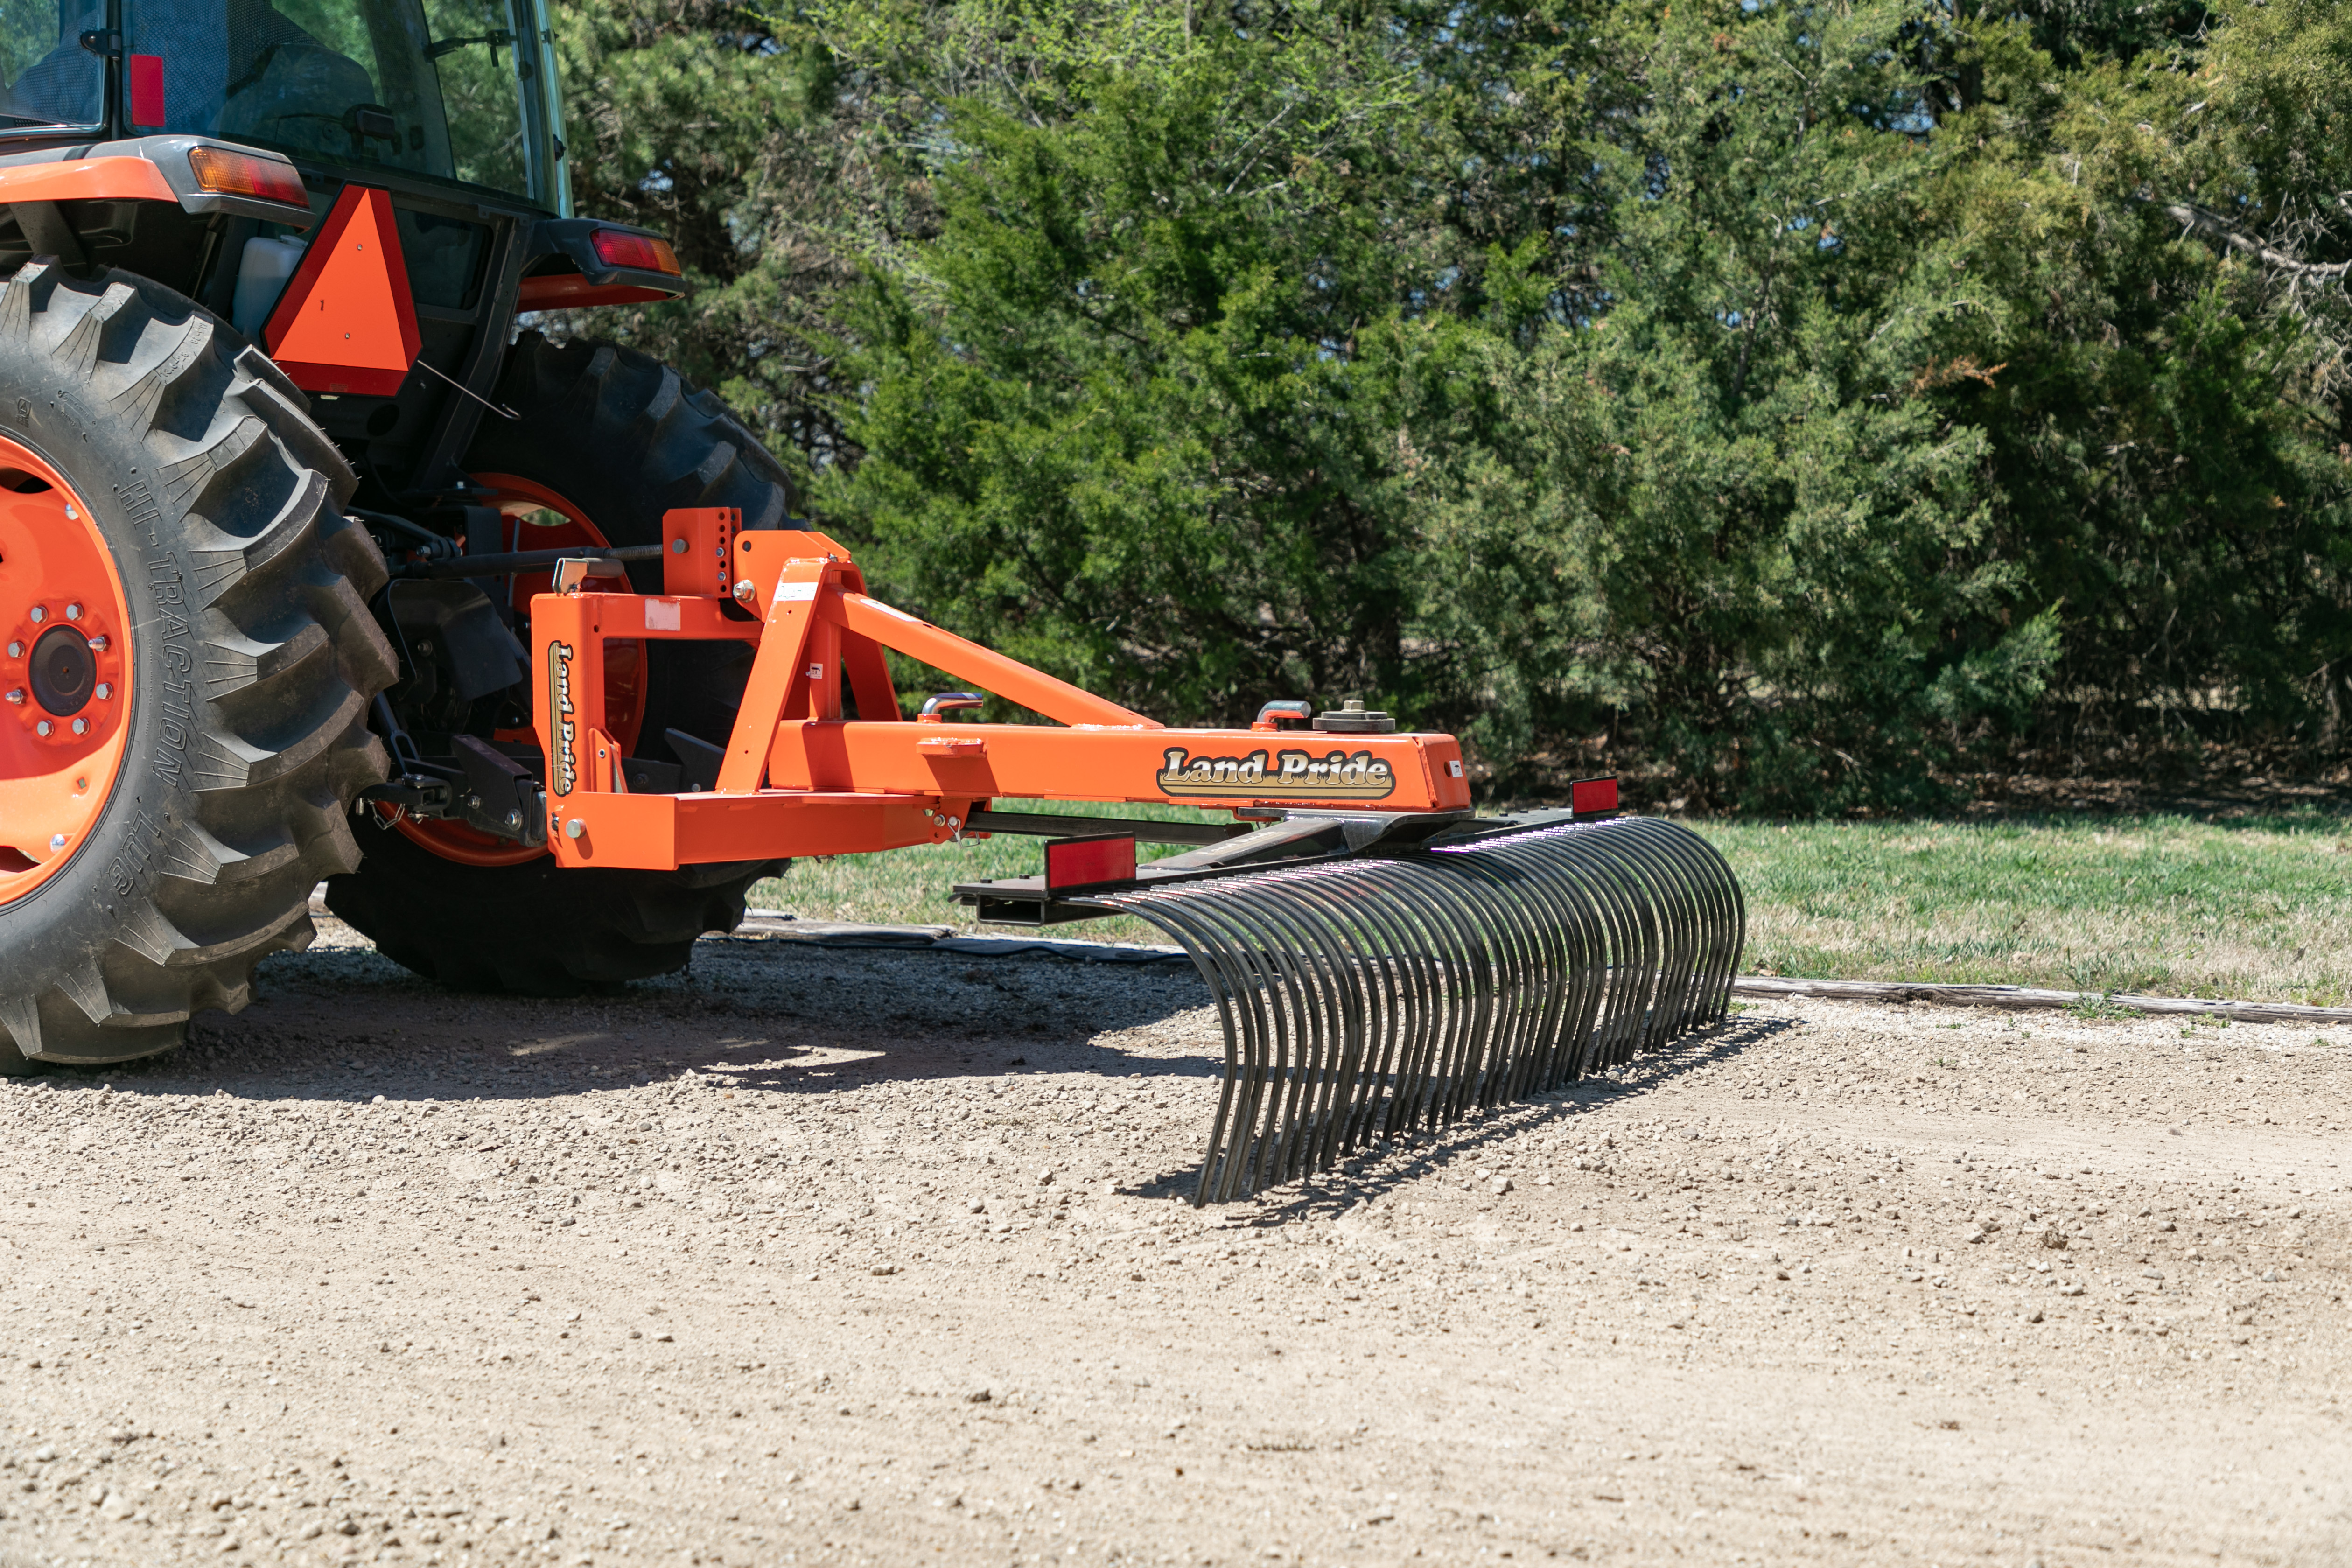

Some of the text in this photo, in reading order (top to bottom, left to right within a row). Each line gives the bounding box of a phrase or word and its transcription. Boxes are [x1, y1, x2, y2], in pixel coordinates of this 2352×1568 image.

[555, 644, 576, 792] Land Pride
[1163, 750, 1389, 785] Land Pride
[107, 809, 161, 897] LUG
